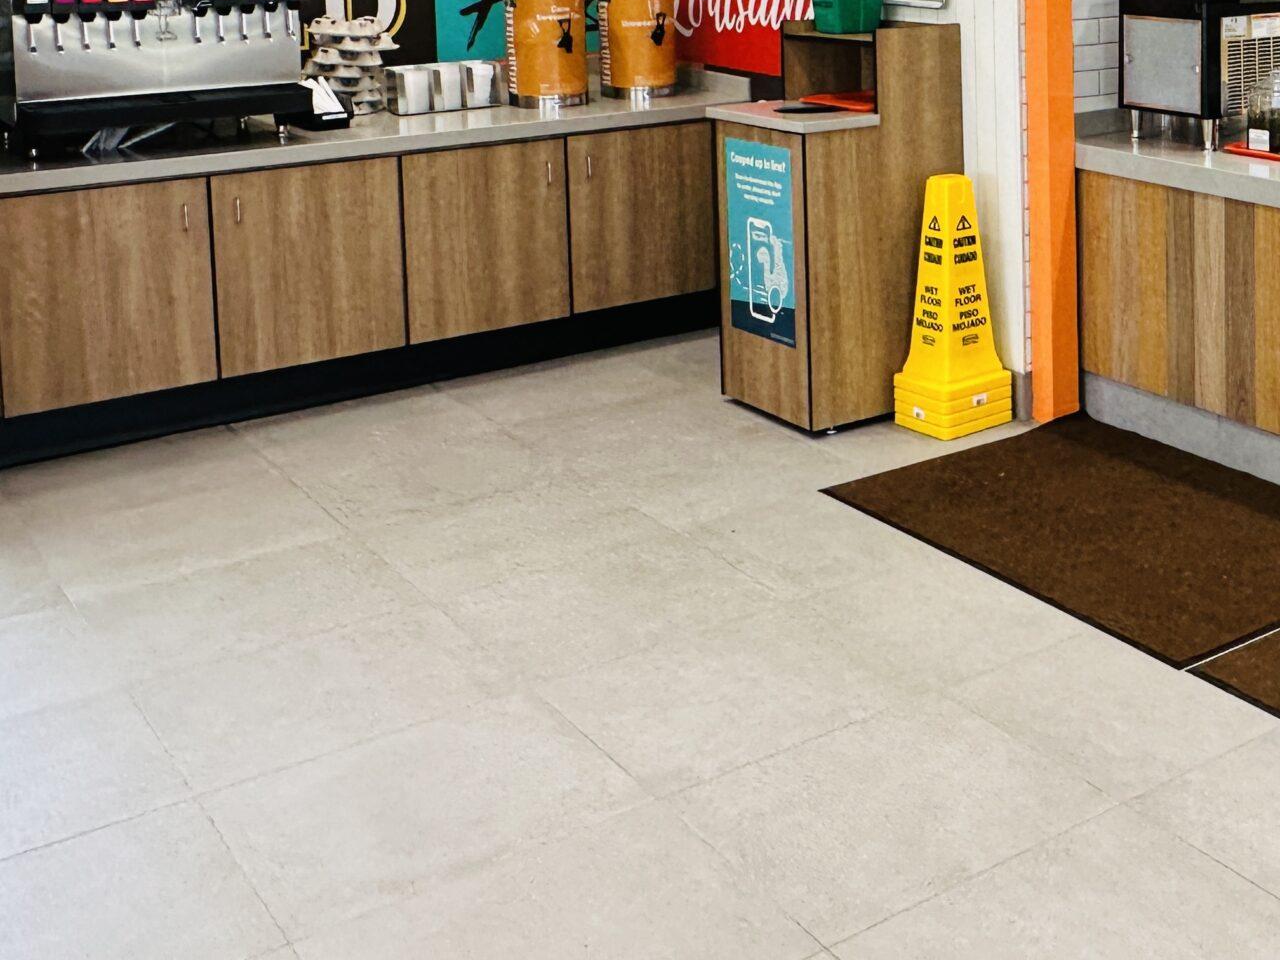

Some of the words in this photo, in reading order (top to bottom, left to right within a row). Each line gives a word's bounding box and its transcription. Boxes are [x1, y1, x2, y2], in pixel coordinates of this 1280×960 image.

[958, 284, 976, 296] WET
[920, 294, 941, 307] FLOOR
[954, 293, 982, 308] FLOOR
[922, 309, 938, 321] PISO
[959, 308, 979, 321] PISO
[916, 317, 944, 333] MOJADO
[952, 317, 987, 333] MOJADO
